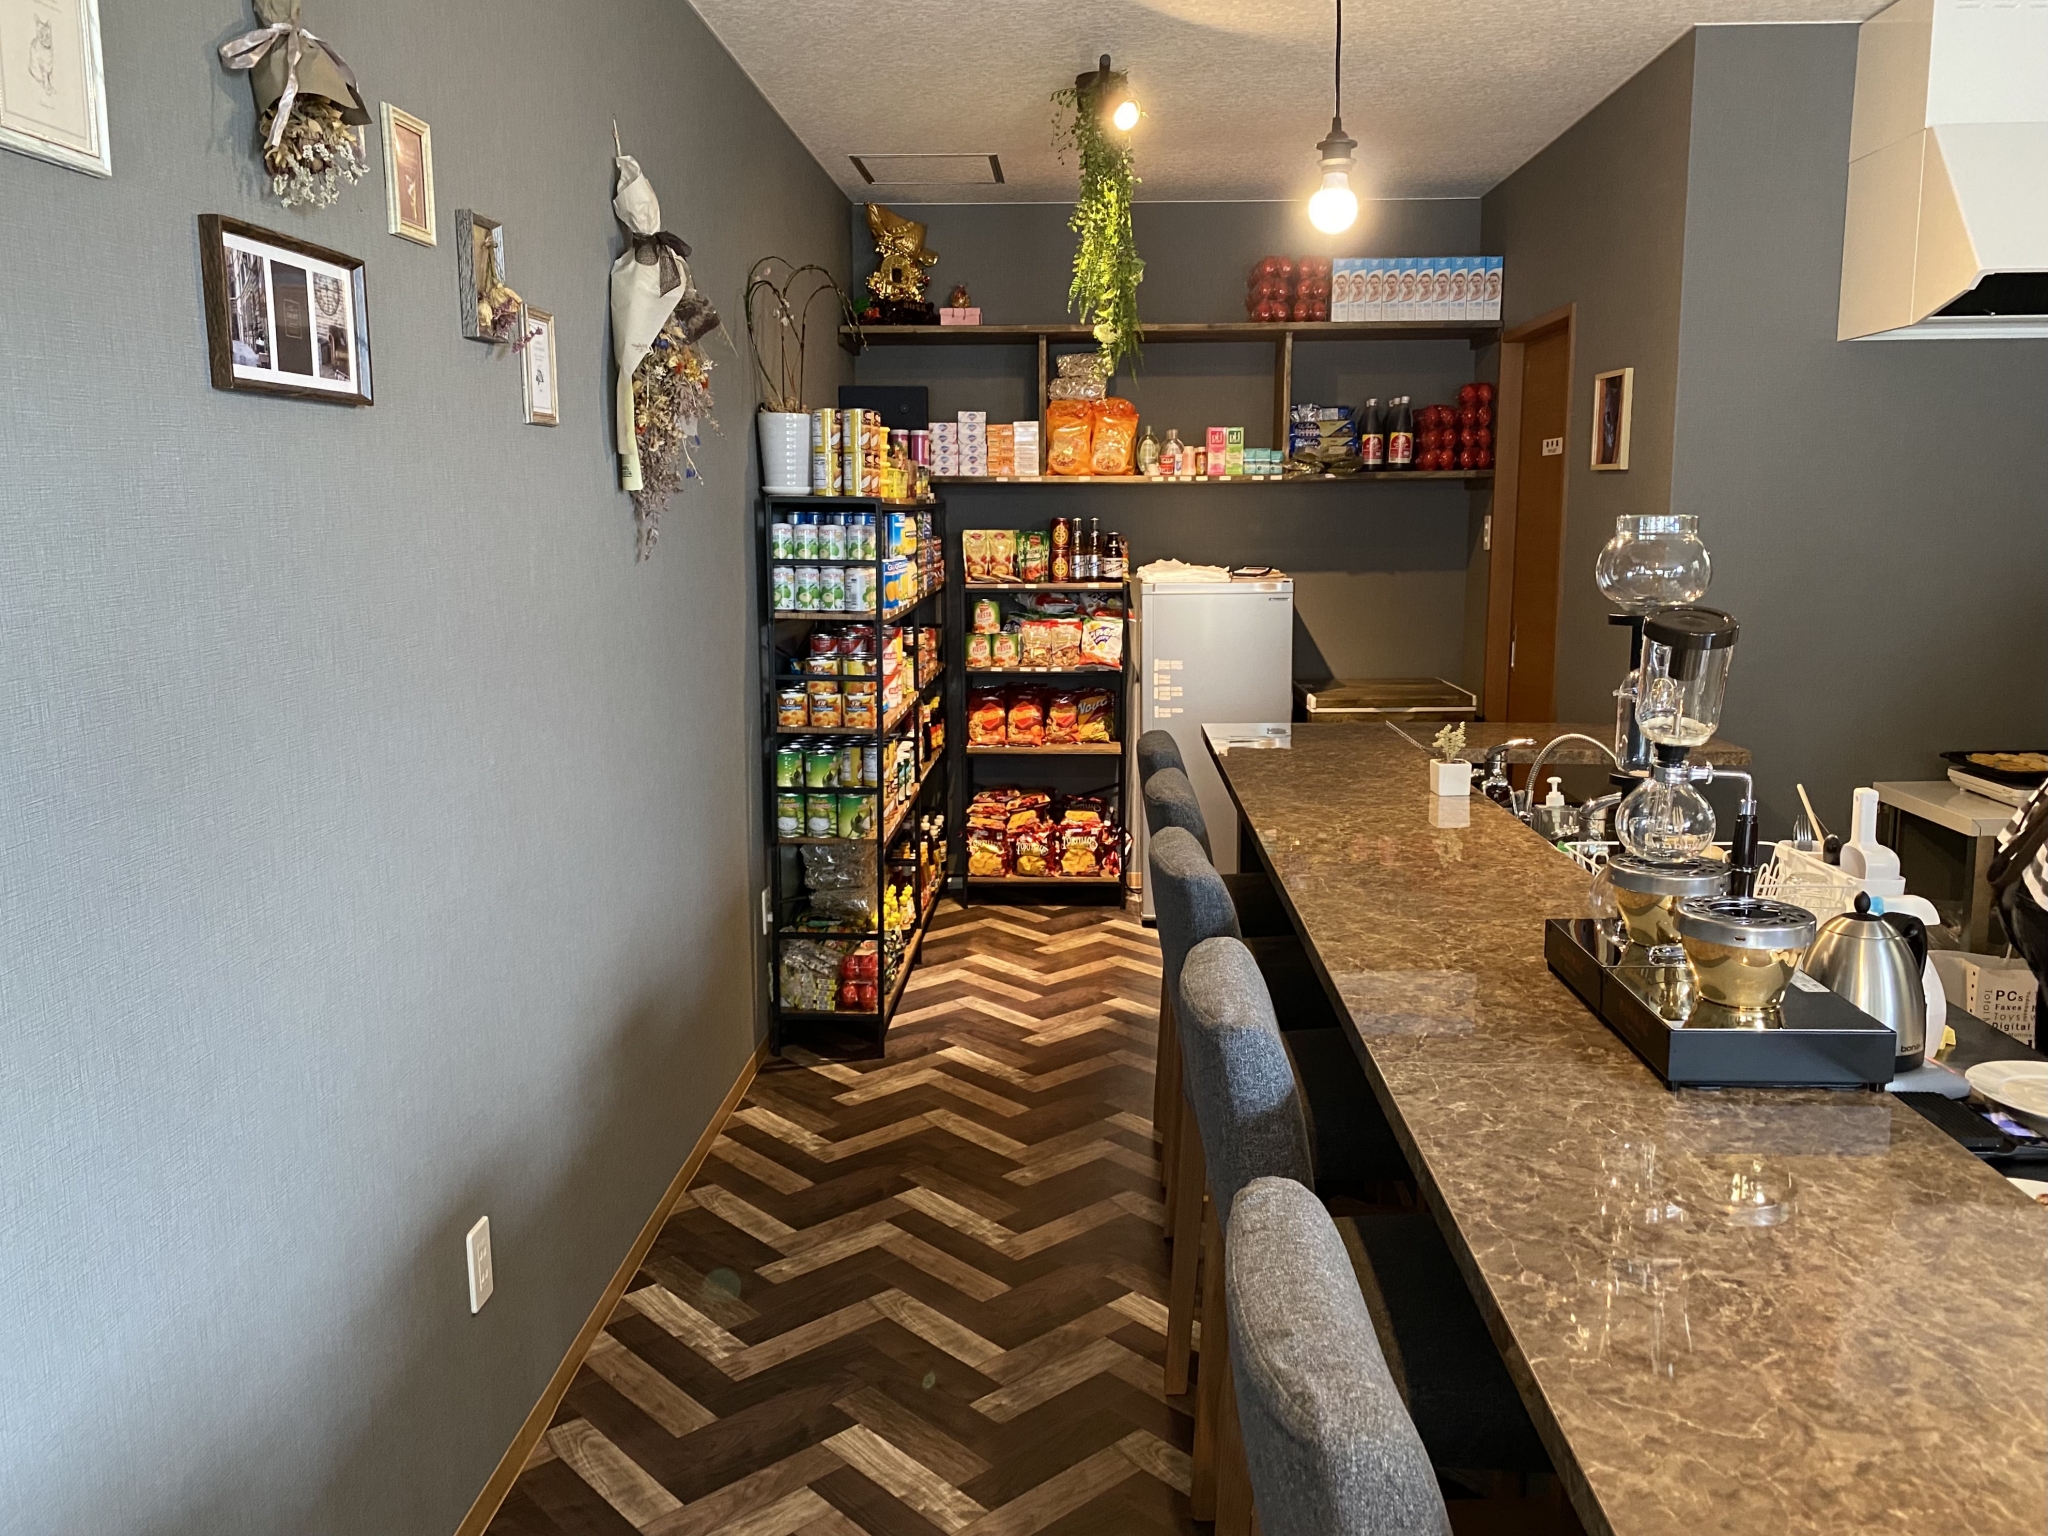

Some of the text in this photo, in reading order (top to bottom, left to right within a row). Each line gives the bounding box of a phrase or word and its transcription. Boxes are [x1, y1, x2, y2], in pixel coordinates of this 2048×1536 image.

[972, 644, 987, 653] FIESTA
[996, 644, 1011, 653] FIESTA
[1995, 989, 2023, 1002] PCs
[1983, 989, 1993, 1014] Total
[1995, 1003, 2022, 1011] Faxes
[1992, 1021, 2031, 1032] Digital
